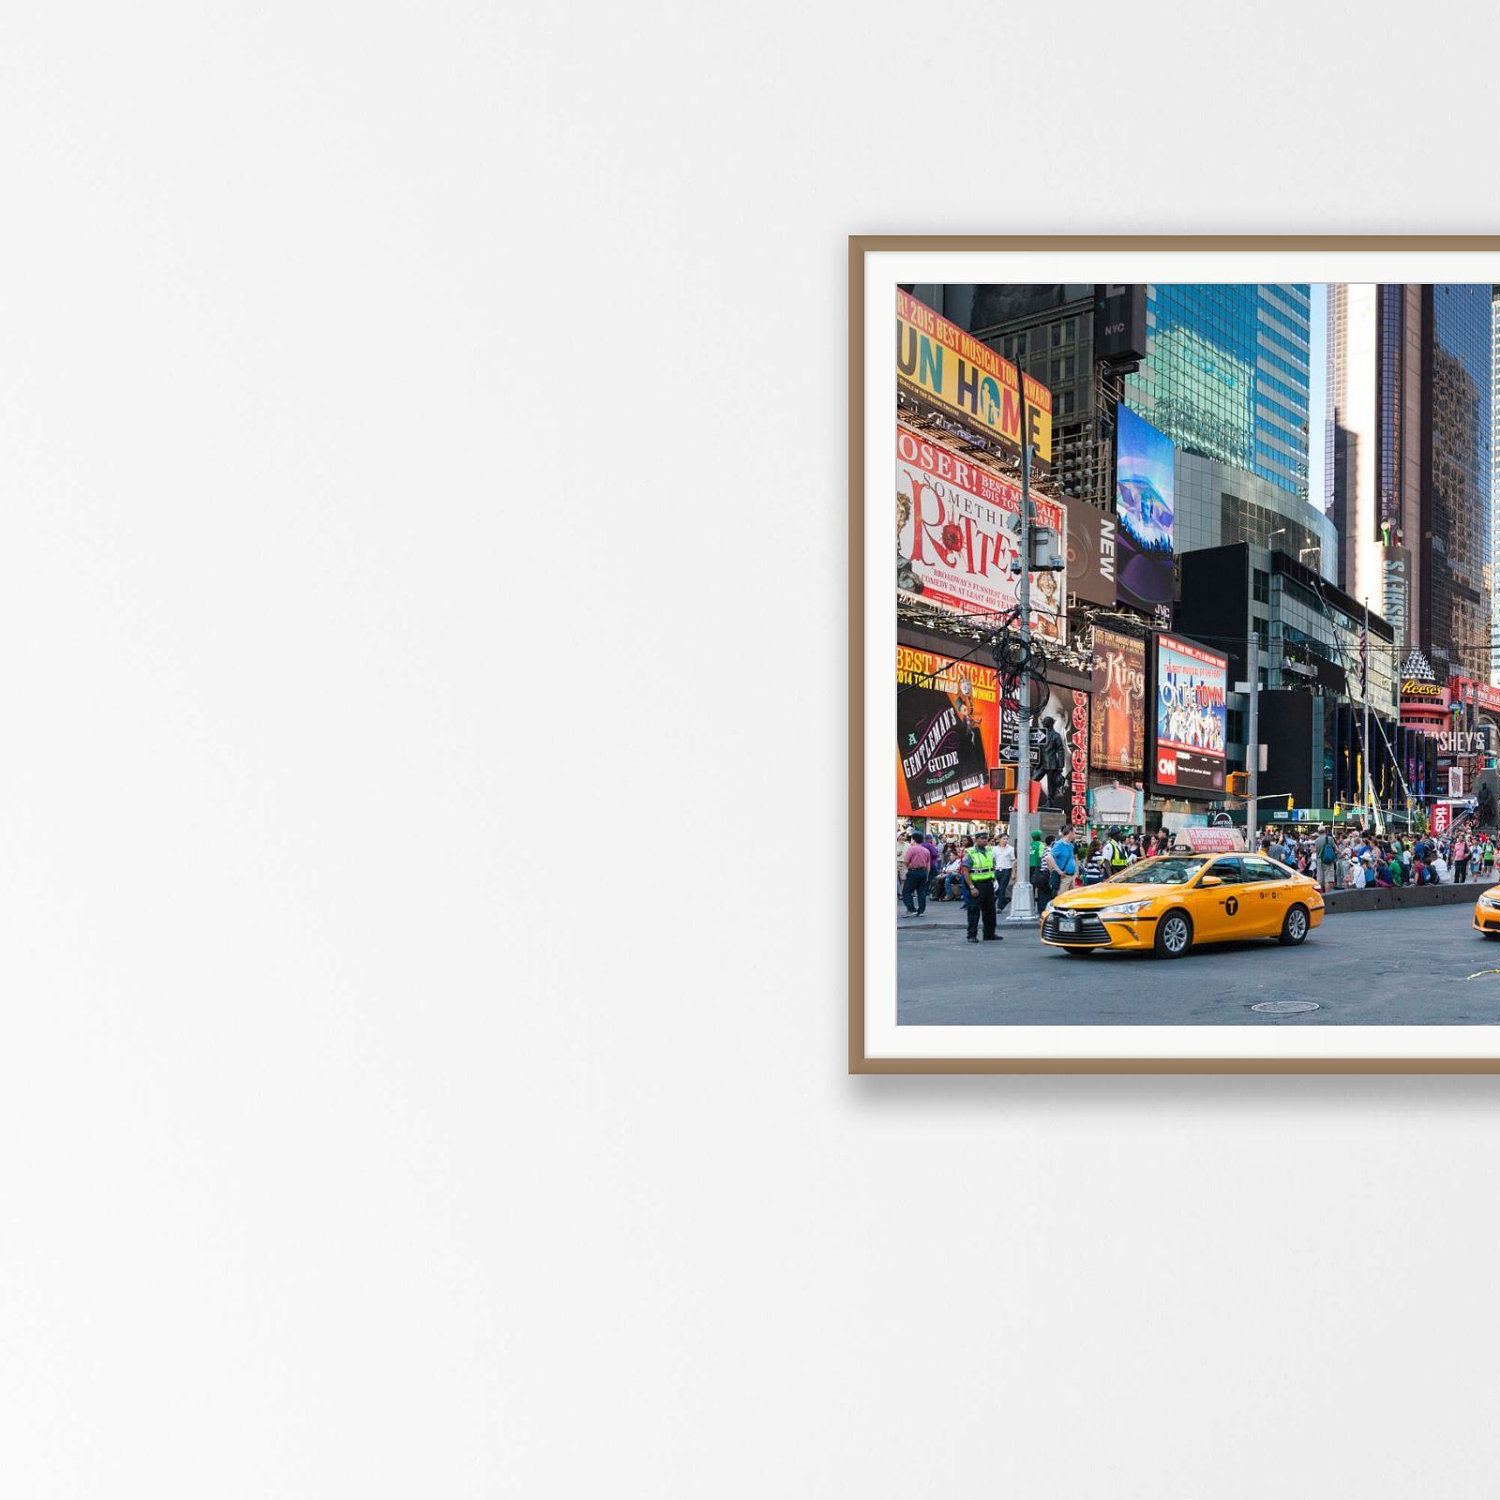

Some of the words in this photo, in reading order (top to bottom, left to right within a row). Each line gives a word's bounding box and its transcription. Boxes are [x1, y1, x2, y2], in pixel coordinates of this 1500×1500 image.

[910, 300, 935, 335] 2015
[936, 318, 960, 351] BEST
[961, 334, 1000, 378] MUSICAL
[1000, 361, 1019, 391] TON
[1024, 377, 1050, 411] AWARD
[981, 475, 1008, 497] BEST
[923, 472, 1004, 528] SOMETHI
[981, 487, 1000, 503] 2015
[1001, 496, 1020, 513] TON
[1100, 518, 1115, 582] NEW
[922, 575, 947, 590] COMEDY
[966, 589, 984, 602] LEAST
[1100, 651, 1145, 700] King
[971, 687, 996, 704] WINNER
[1196, 684, 1223, 708] TOWN
[908, 732, 918, 746] A
[928, 751, 959, 773] GUIDE
[1071, 690, 1087, 825] CHICAGO
[1435, 806, 1448, 833] tkts
